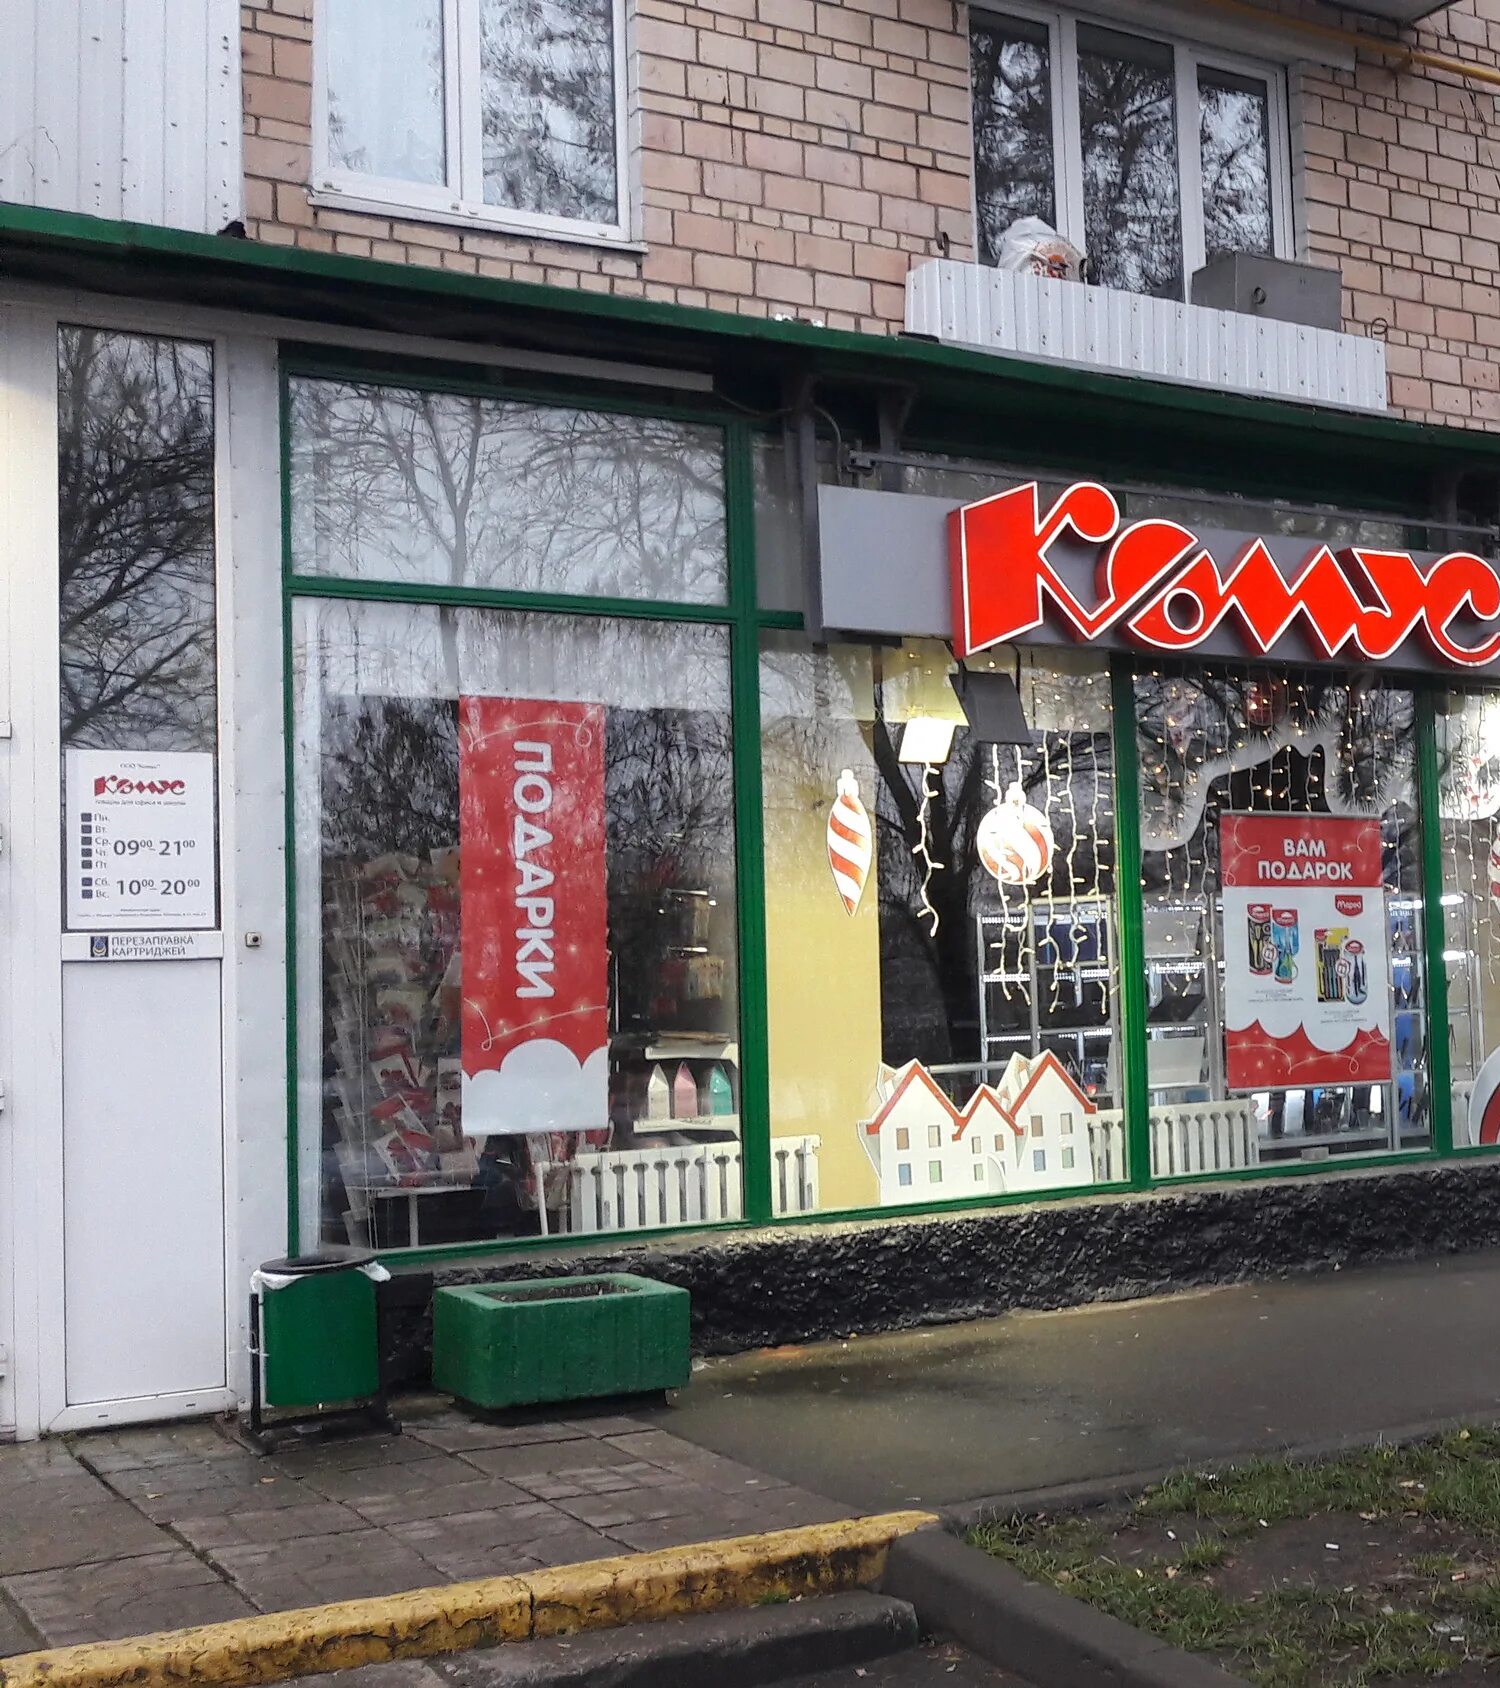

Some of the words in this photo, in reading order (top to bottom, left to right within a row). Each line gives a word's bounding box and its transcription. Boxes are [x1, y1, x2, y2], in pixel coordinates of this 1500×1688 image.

[94, 774, 185, 796] Комус
[1283, 838, 1327, 858] ВАМ
[512, 740, 555, 999] ПОДАРКИ
[1258, 860, 1353, 880] ПОДАРОК
[111, 935, 194, 946] ПЕРЕЗАПРАВКА
[111, 946, 186, 958] КАРТРИДЖЕЙ
